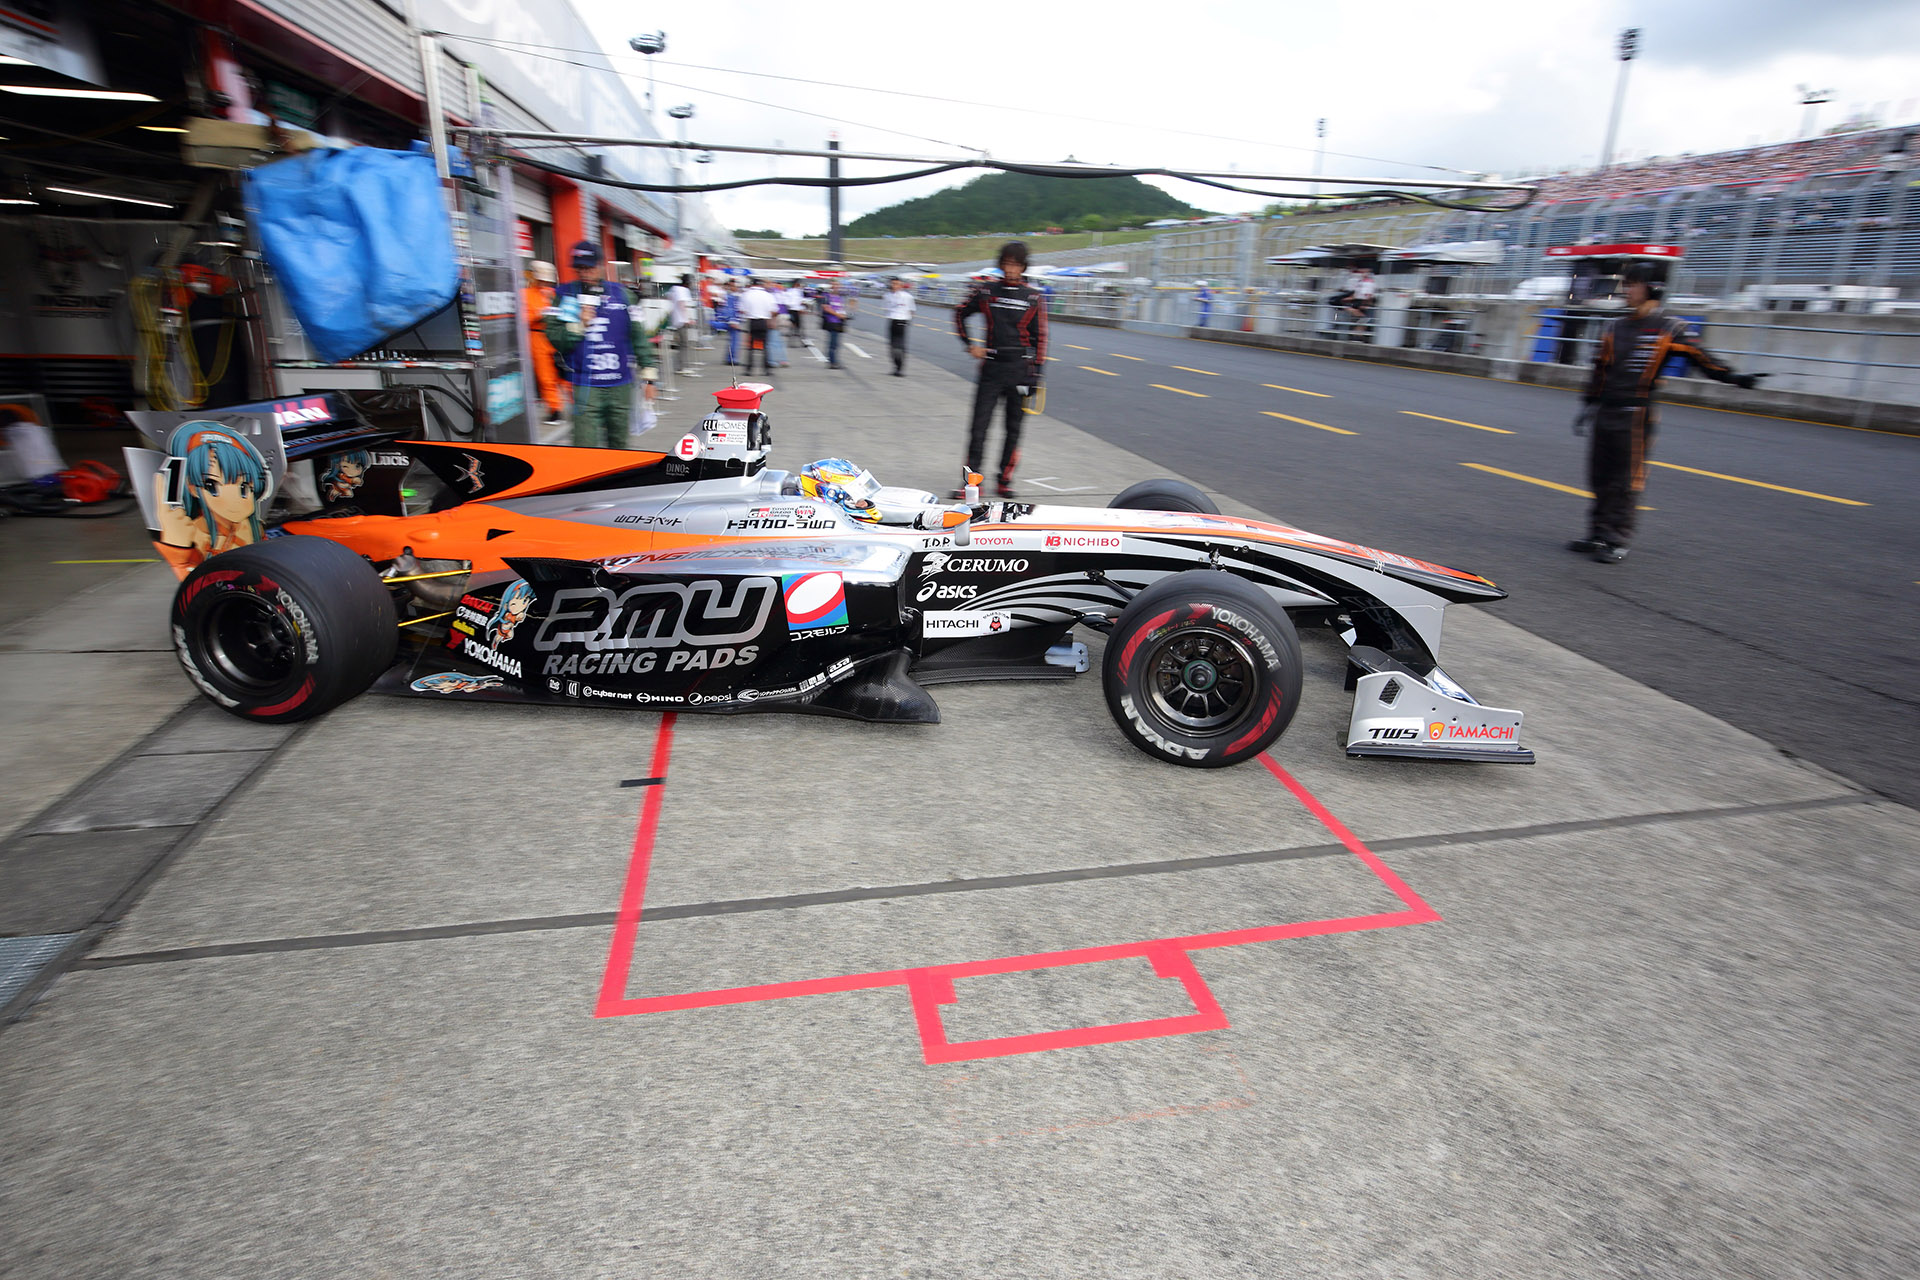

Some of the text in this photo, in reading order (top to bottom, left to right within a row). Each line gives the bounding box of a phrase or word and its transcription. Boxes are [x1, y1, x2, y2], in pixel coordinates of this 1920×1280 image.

[718, 421, 747, 431] HOMES
[681, 439, 694, 455] E
[159, 456, 188, 505] 1
[748, 509, 769, 518] GR
[614, 515, 682, 527] 山口トヨペット
[974, 537, 1014, 546] TOYOTA
[1063, 537, 1120, 547] NICHIBO
[947, 558, 1029, 572] CERUMO
[936, 585, 977, 599] asics
[276, 587, 319, 666] YOKOHAMA
[926, 619, 979, 629] HITACHI
[1211, 605, 1282, 674] YOKOHAMA
[463, 637, 522, 678] YOKOHAMA
[542, 645, 760, 675] RACING PADS
[651, 695, 685, 703] HINO
[703, 692, 732, 703] pepsi
[1120, 694, 1211, 761] ADVAN
[1368, 727, 1420, 741] TWS
[1448, 725, 1514, 740] TAMACHI
